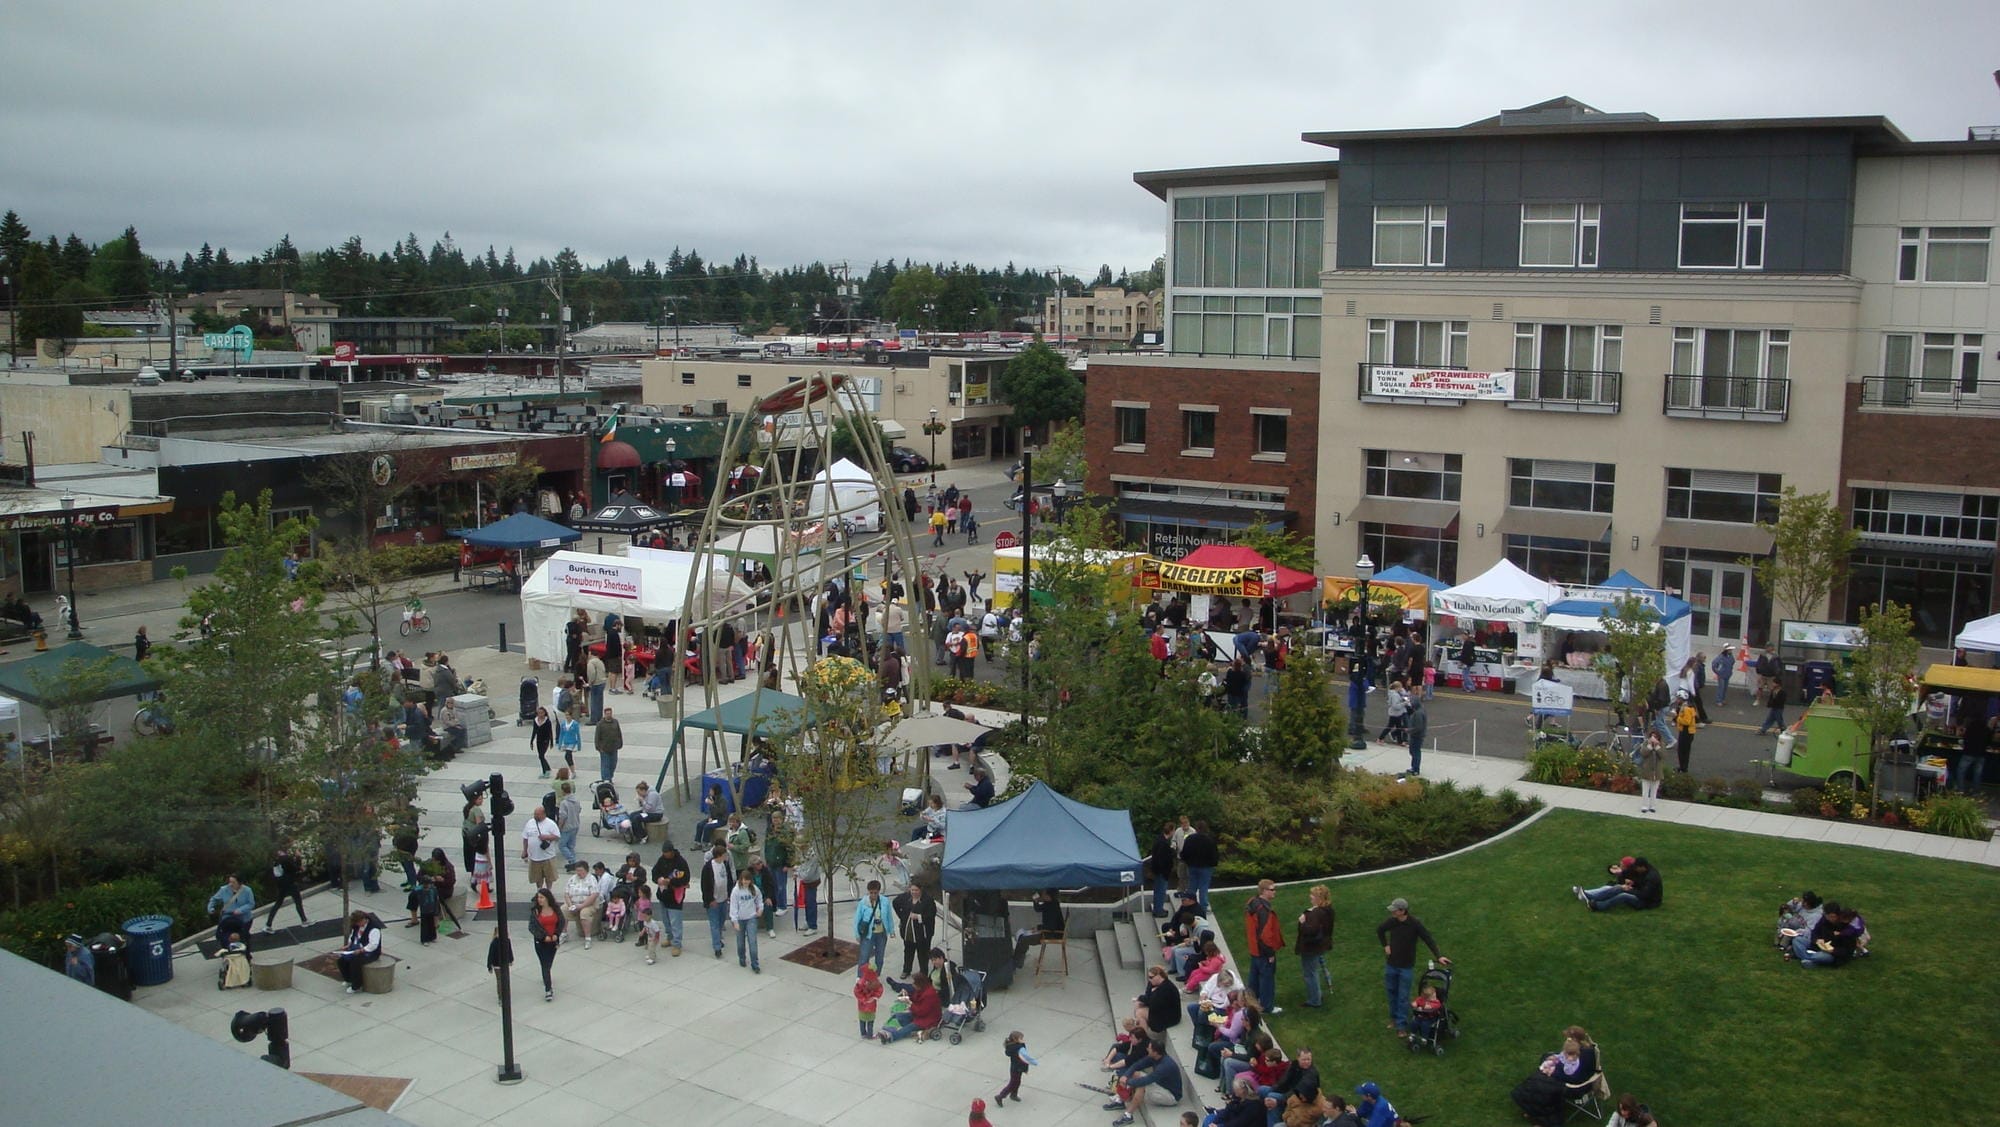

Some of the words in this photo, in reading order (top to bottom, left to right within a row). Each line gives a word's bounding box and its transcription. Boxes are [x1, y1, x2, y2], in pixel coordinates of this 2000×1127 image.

[204, 335, 250, 347] CARPETS
[1412, 371, 1430, 382] WILD
[1430, 371, 1491, 379] STRAWBERRY
[996, 538, 1015, 548] STOP
[1154, 533, 1184, 544] Retail
[1186, 535, 1209, 546] Now
[1160, 546, 1189, 557] (425)
[568, 564, 596, 574] Burien
[599, 568, 619, 577] Arts!
[1161, 564, 1242, 585] ZIEGLER'S
[565, 575, 602, 590] Strawberry
[604, 579, 637, 592] Shortcake
[1161, 581, 1215, 595] BRATWURST
[1216, 586, 1242, 596] HAUS
[1454, 601, 1480, 612] Italian
[1483, 604, 1525, 614] Meatballs
